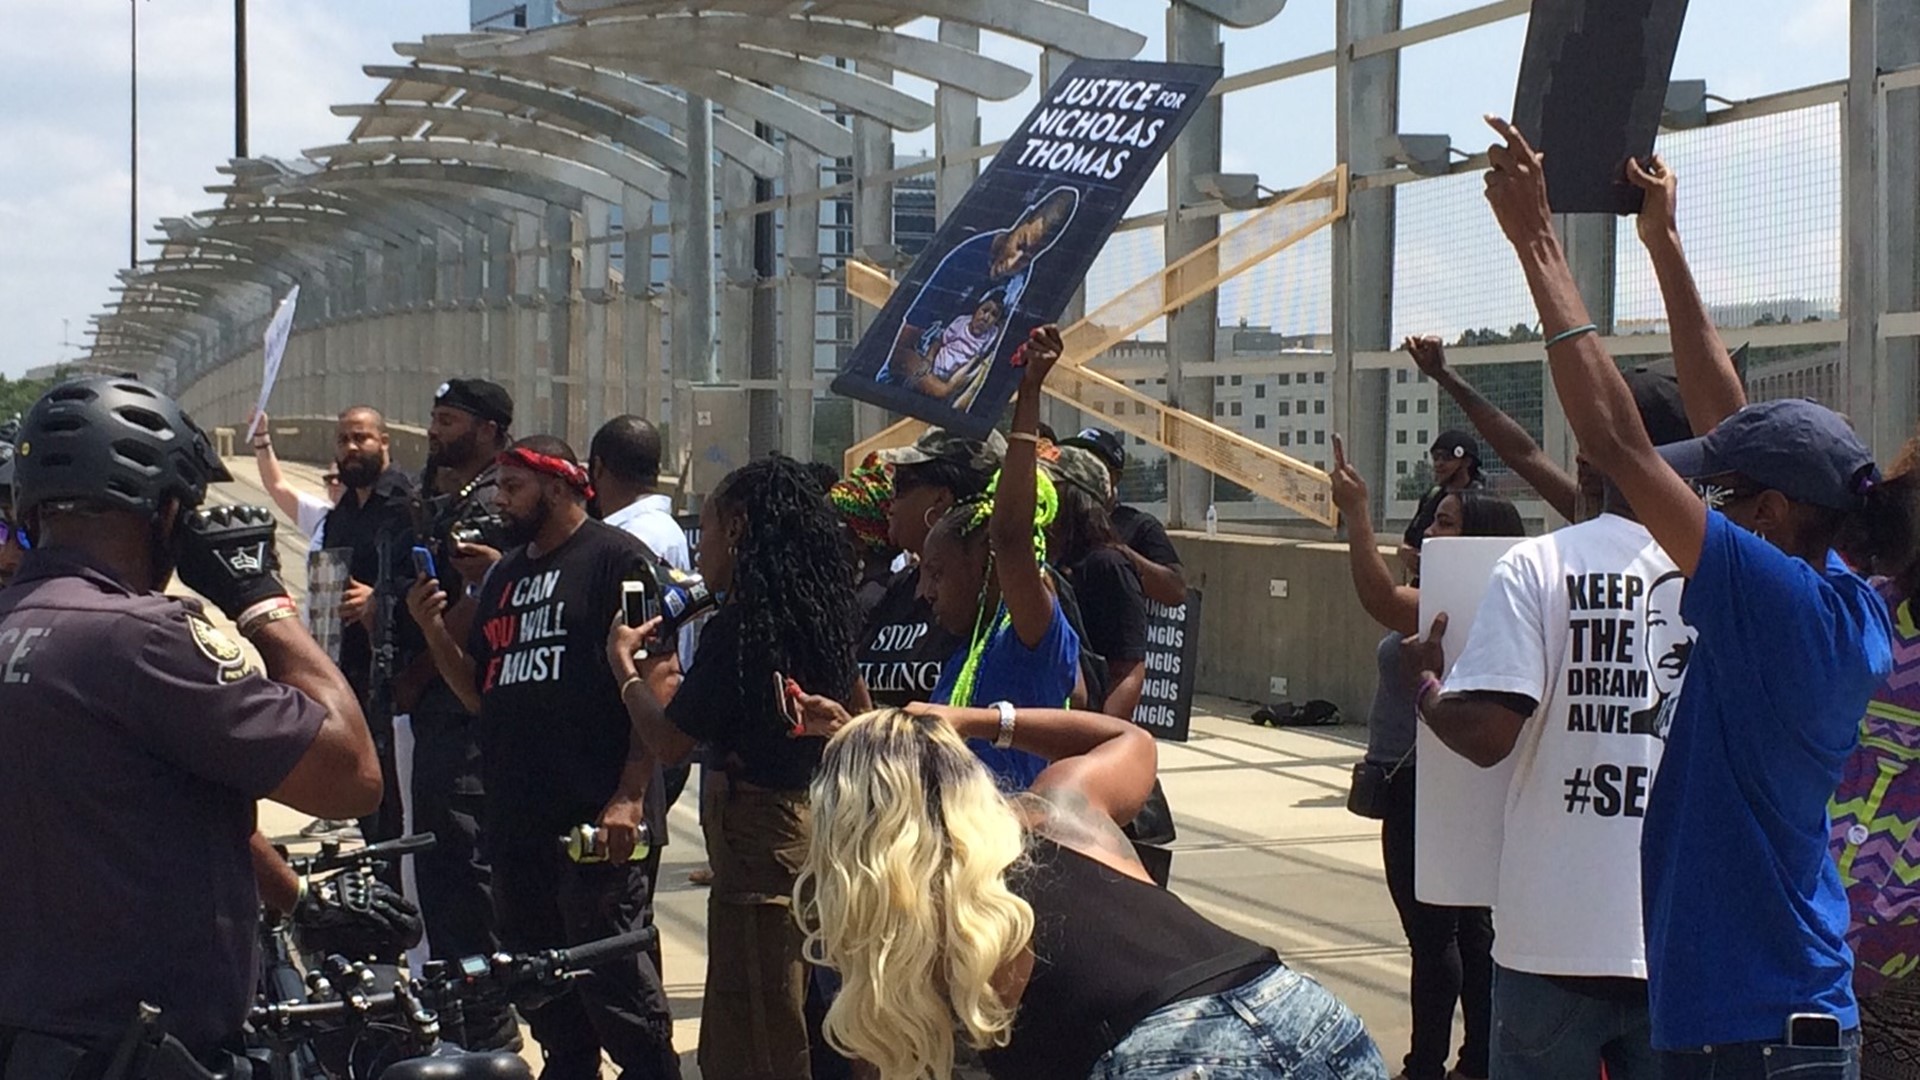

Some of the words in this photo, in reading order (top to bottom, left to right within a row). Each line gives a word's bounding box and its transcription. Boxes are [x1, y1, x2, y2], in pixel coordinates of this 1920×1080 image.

[1052, 77, 1162, 113] JUSTICE
[1154, 90, 1187, 110] FOR
[1028, 107, 1165, 149] NICHOLAS
[1016, 138, 1131, 181] THOMAS
[499, 580, 513, 610] I
[511, 569, 561, 608] CAN
[1565, 572, 1644, 612] KEEP
[519, 601, 569, 644] WILL
[870, 621, 929, 652] STOP
[1569, 617, 1636, 664] THE
[498, 644, 566, 687] MUST
[857, 660, 942, 692] LLING
[1567, 667, 1649, 698] DREAM
[1563, 763, 1653, 818] #SE
